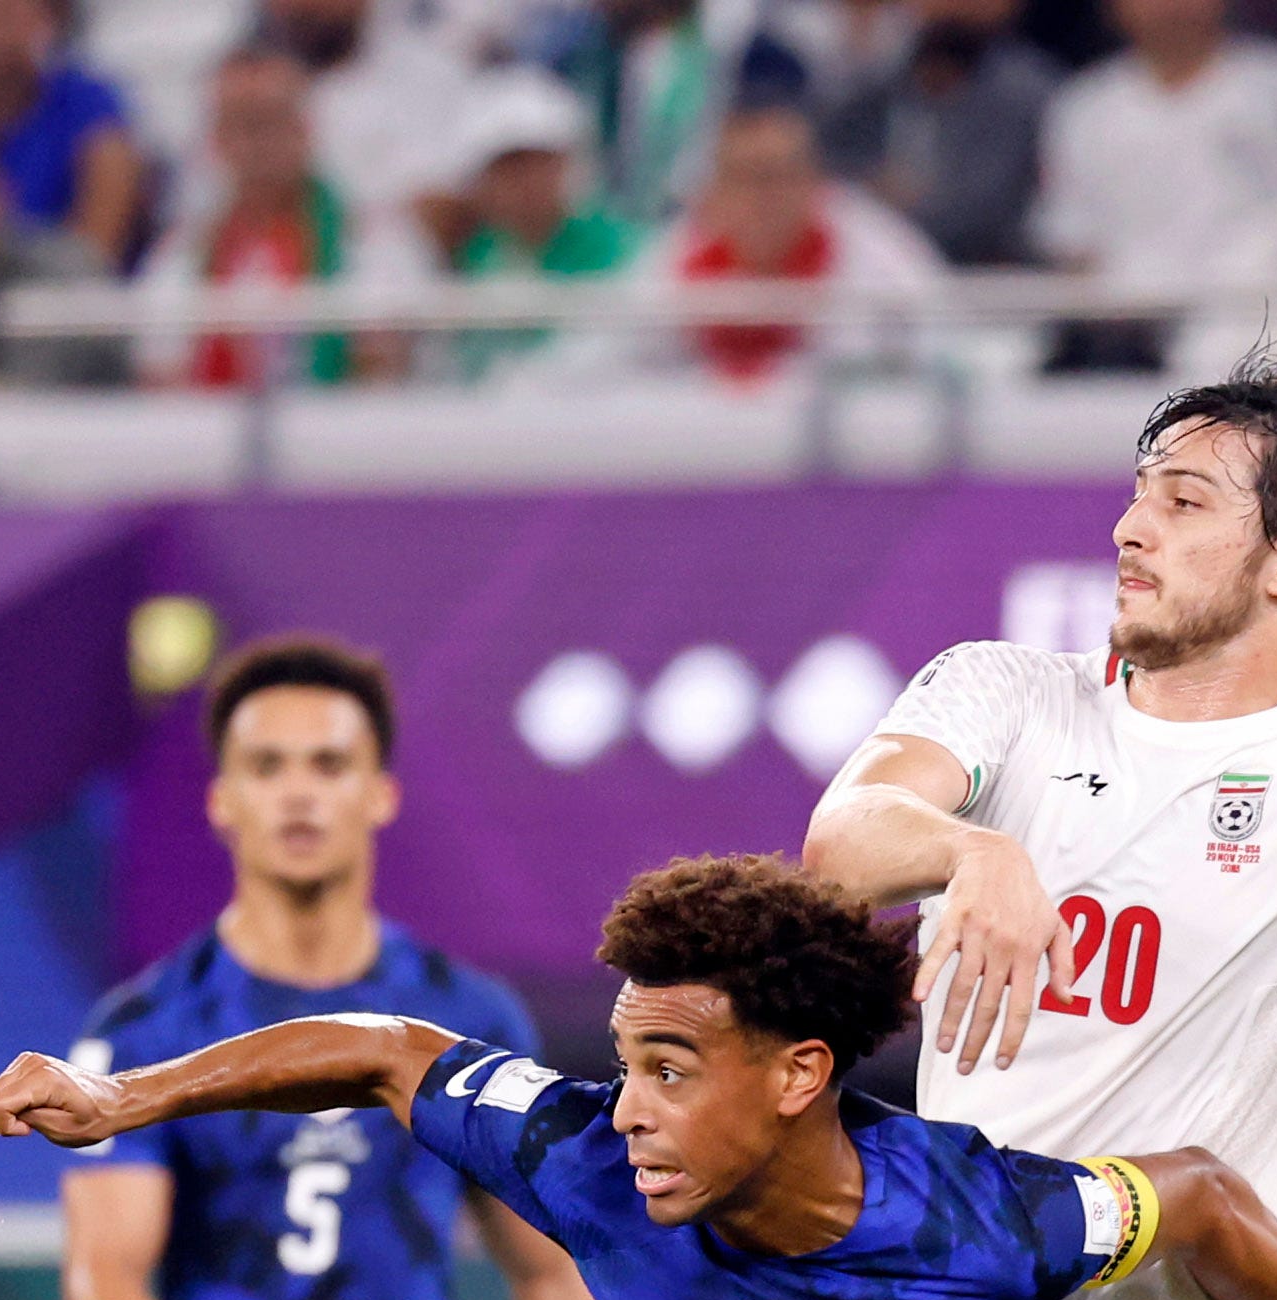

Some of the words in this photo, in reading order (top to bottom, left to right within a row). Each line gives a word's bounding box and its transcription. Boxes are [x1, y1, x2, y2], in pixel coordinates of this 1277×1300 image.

[1205, 852, 1217, 861] 29
[1217, 853, 1236, 862] NOV
[1237, 854, 1260, 863] 2022
[1038, 894, 1162, 1025] 20
[276, 1160, 352, 1276] 5
